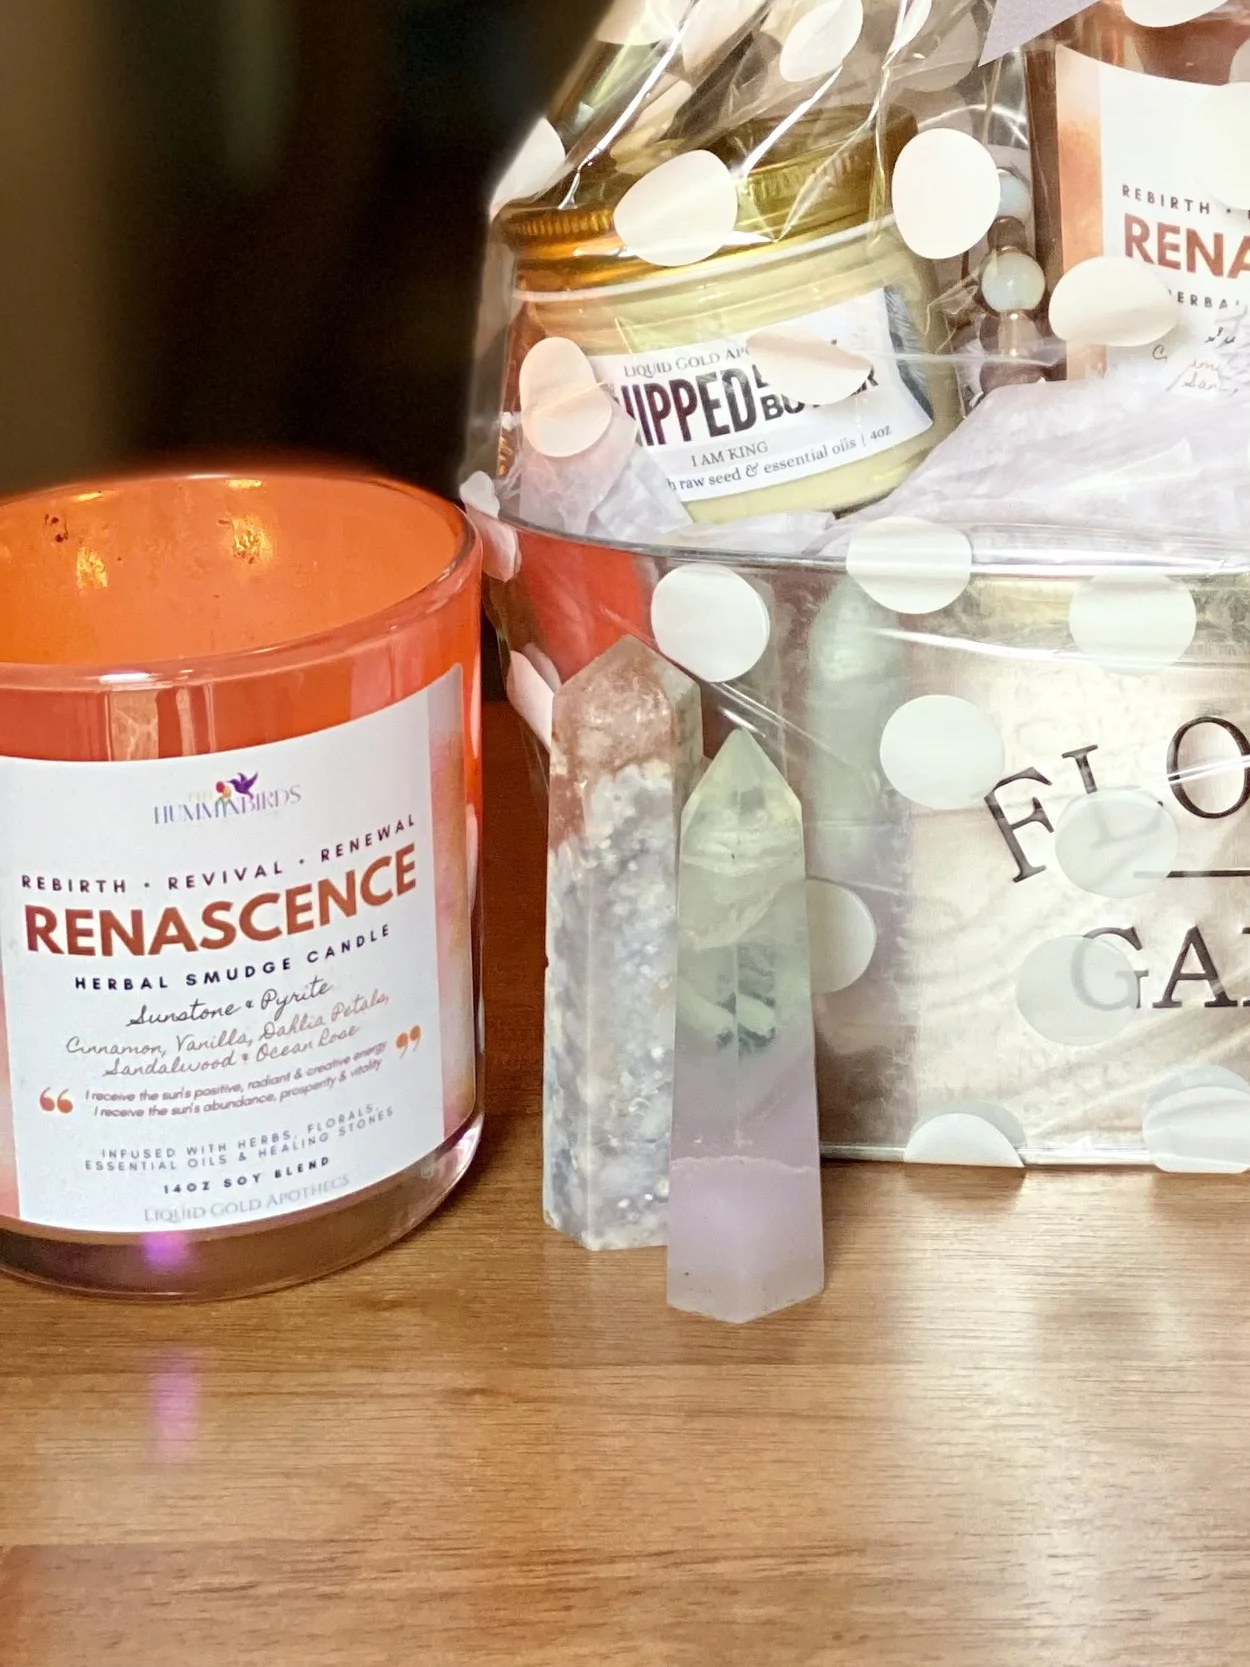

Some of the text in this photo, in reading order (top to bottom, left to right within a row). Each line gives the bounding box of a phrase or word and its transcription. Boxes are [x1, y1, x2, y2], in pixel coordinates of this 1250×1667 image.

[1122, 184, 1210, 215] REBIRTH
[1169, 290, 1240, 310] ERBA
[623, 361, 672, 379] LIQUID
[675, 352, 721, 370] GOLD
[680, 476, 705, 490] raw
[709, 467, 741, 485] seed
[745, 462, 759, 477] &
[764, 444, 828, 474] essential
[832, 437, 857, 455] oils
[691, 440, 768, 467] I AM KING
[22, 814, 415, 894] REBIRTH REVIVAL RENEWAL
[25, 842, 417, 957] RENASCENCE
[75, 924, 390, 990] HERBAL SMUDGE CANDLE
[66, 987, 390, 1057] Cinnamon, Vanilla, Dahlia Petals,
[125, 998, 241, 1027] Sunstone
[261, 975, 335, 1021] Pyrite
[92, 1091, 136, 1102] receive
[140, 1088, 160, 1101] the
[194, 1081, 244, 1103] positive,
[247, 1072, 291, 1091] radiant
[294, 1068, 303, 1079] &
[306, 1055, 351, 1077] creative
[353, 1040, 388, 1061] energy
[102, 1049, 238, 1077] Sandalwood
[256, 1038, 314, 1063] Ocean
[101, 1106, 145, 1118] receive
[148, 1104, 168, 1117] the
[203, 1091, 277, 1113] abundance,
[280, 1075, 336, 1103] prosperity
[338, 1070, 347, 1083] &
[350, 1058, 382, 1078] vitality
[85, 1105, 394, 1172] ESSENTIAL OILS & HEALING STONES
[102, 1147, 176, 1159] INFUSED
[186, 1142, 227, 1156] WITH
[223, 1172, 262, 1188] SOY
[274, 1156, 330, 1179] BLEND
[144, 1206, 206, 1224] LIQUID
[210, 1197, 262, 1217] GOLD
